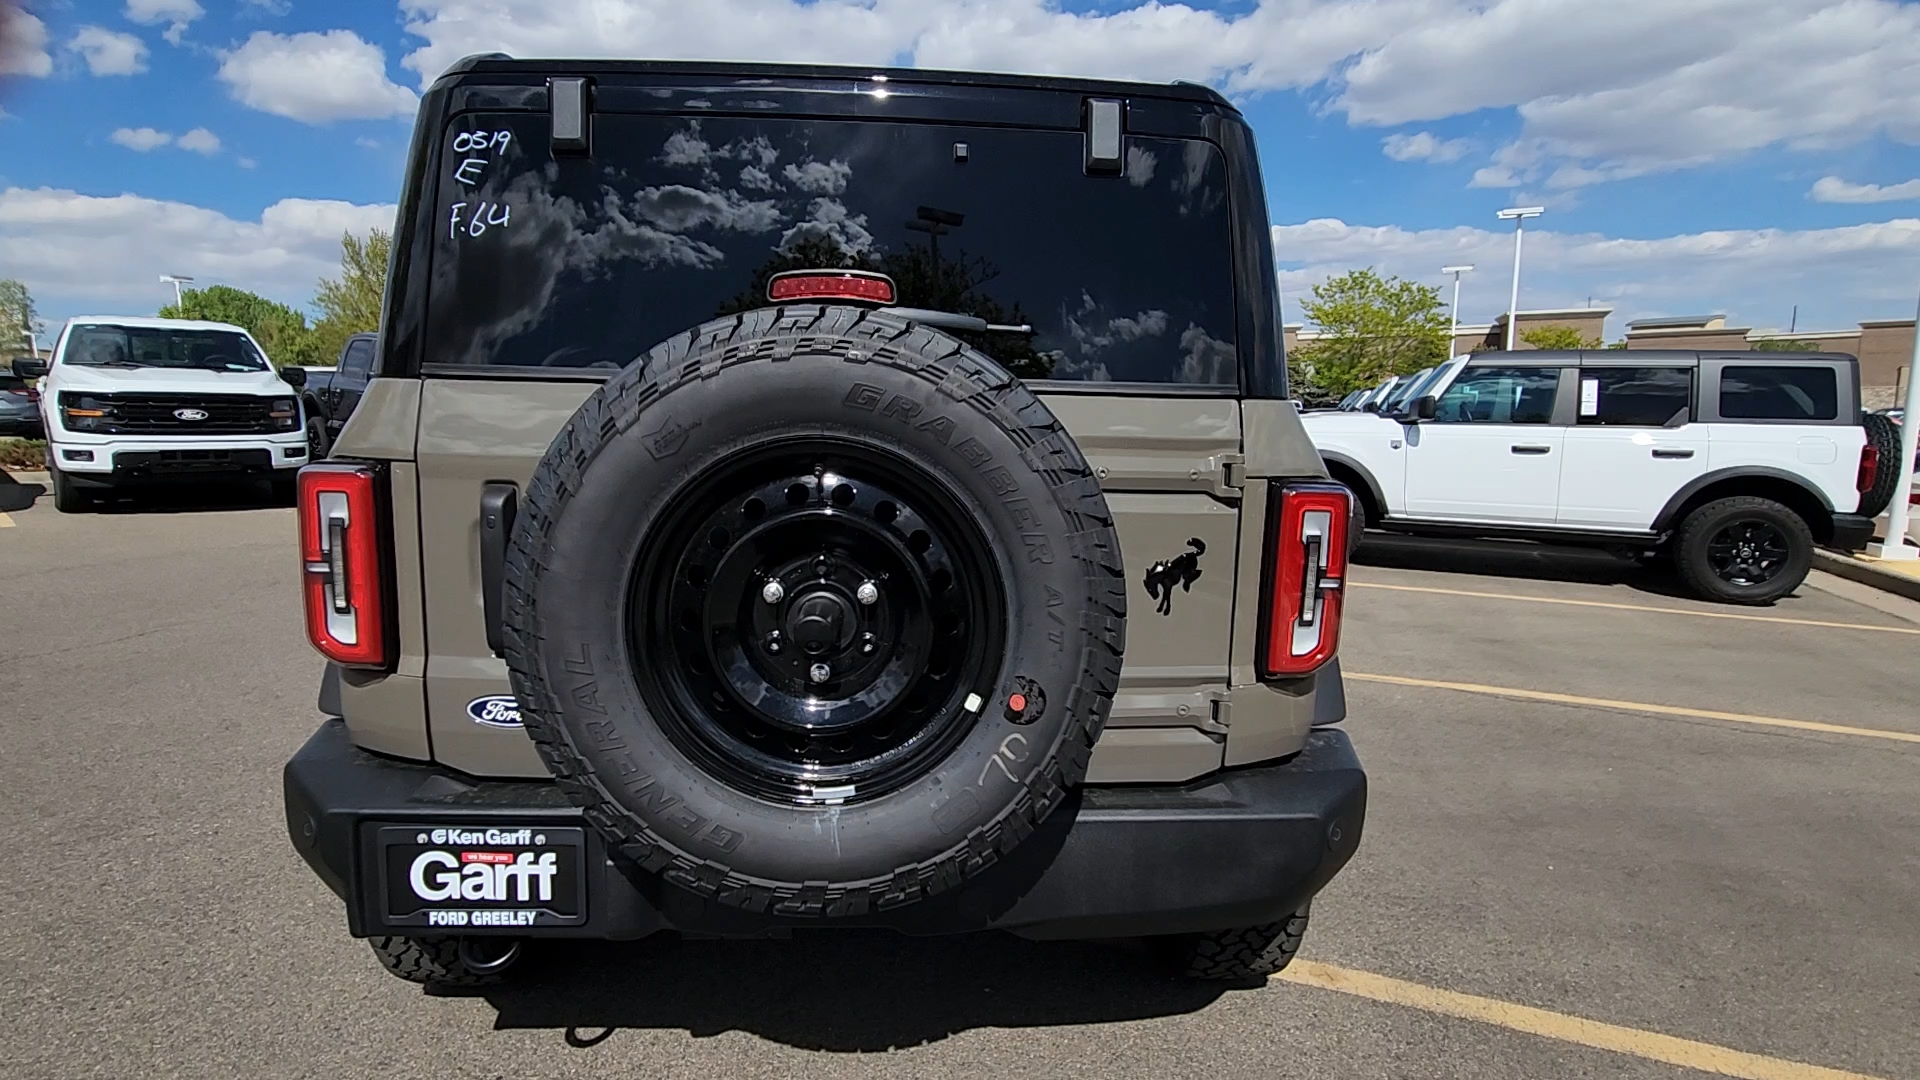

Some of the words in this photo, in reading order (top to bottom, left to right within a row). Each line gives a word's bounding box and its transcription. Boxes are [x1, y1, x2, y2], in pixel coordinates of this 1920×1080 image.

[454, 158, 489, 185] E
[841, 381, 1055, 565] GRABBER
[564, 642, 747, 854] GENERAL
[447, 829, 484, 845] Ken
[485, 829, 532, 845] Garff
[467, 853, 477, 861] we
[478, 853, 494, 861] hear
[495, 854, 508, 862] you
[409, 850, 557, 902] Garff
[429, 911, 468, 926] FORD
[470, 911, 537, 926] GREELEY
